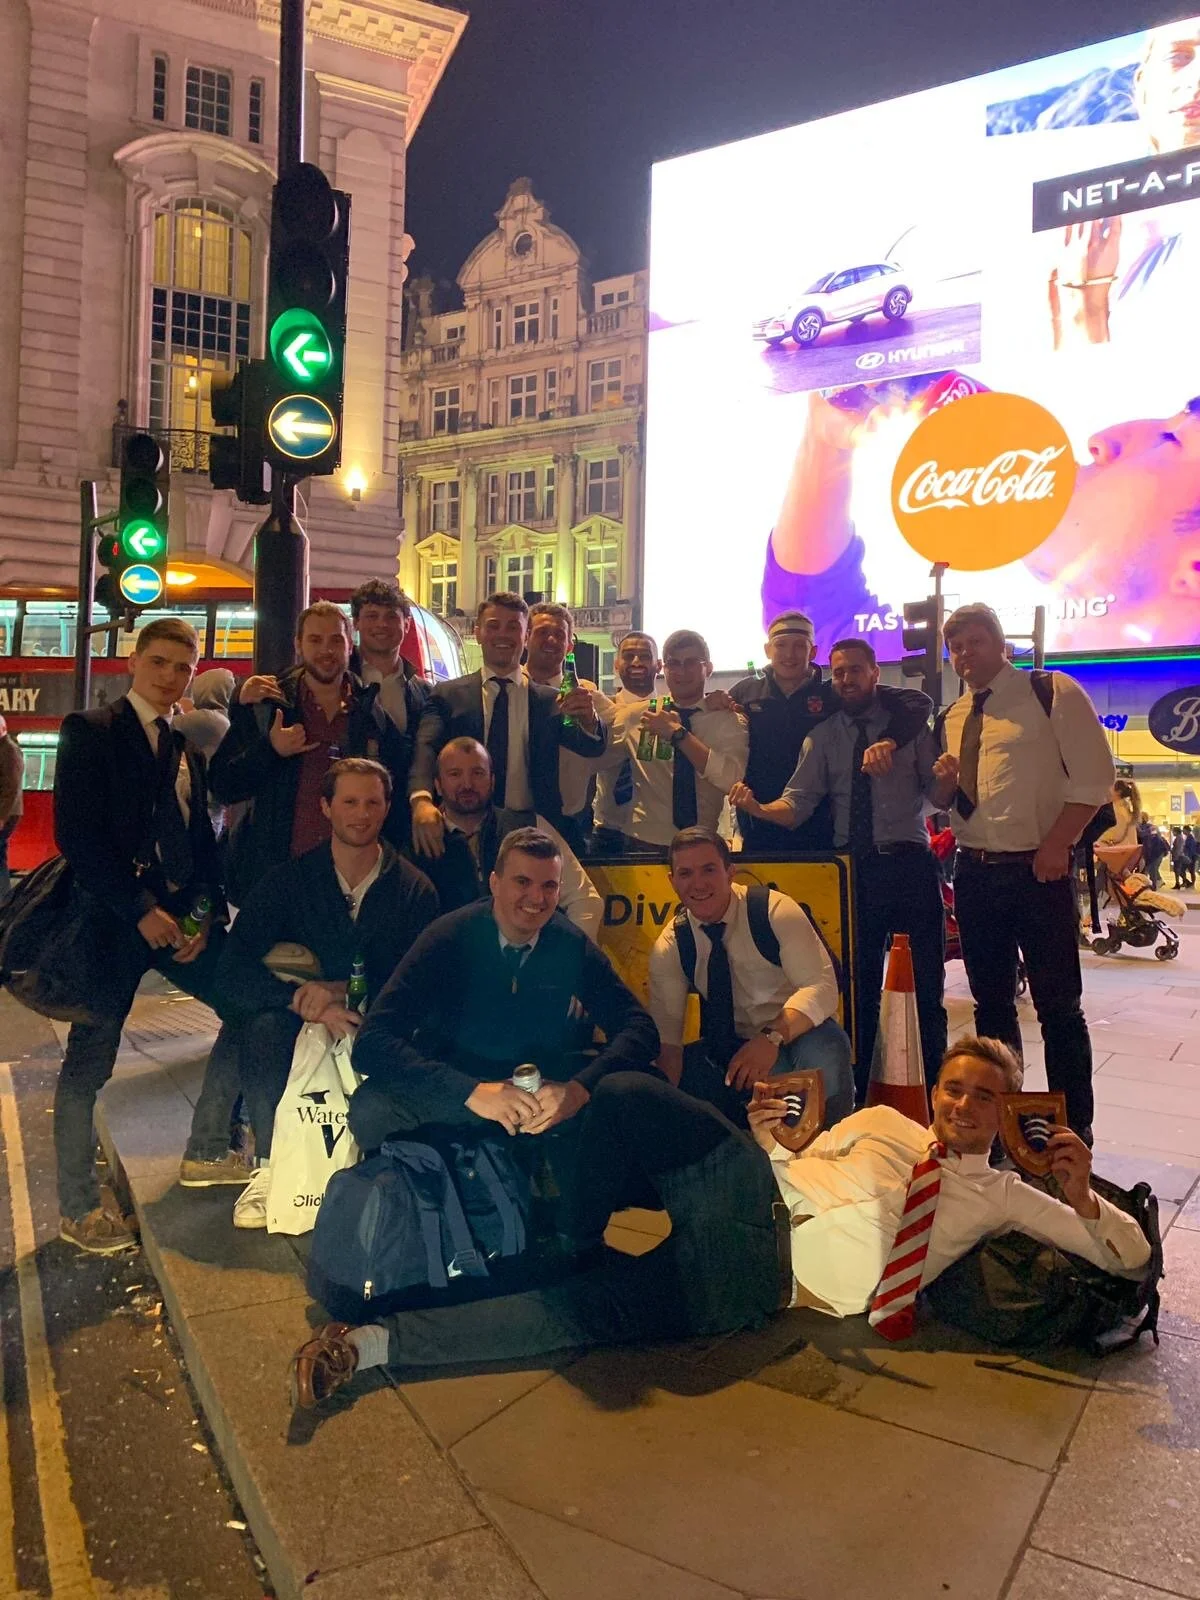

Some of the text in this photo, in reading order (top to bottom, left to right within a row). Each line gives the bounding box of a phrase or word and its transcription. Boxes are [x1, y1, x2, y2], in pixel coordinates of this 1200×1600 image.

[888, 339, 966, 363] HYUN
[899, 444, 1067, 513] Coca-Cola
[853, 612, 928, 632] TAS
[296, 1106, 348, 1124] Wate
[293, 1193, 326, 1207] Clic
